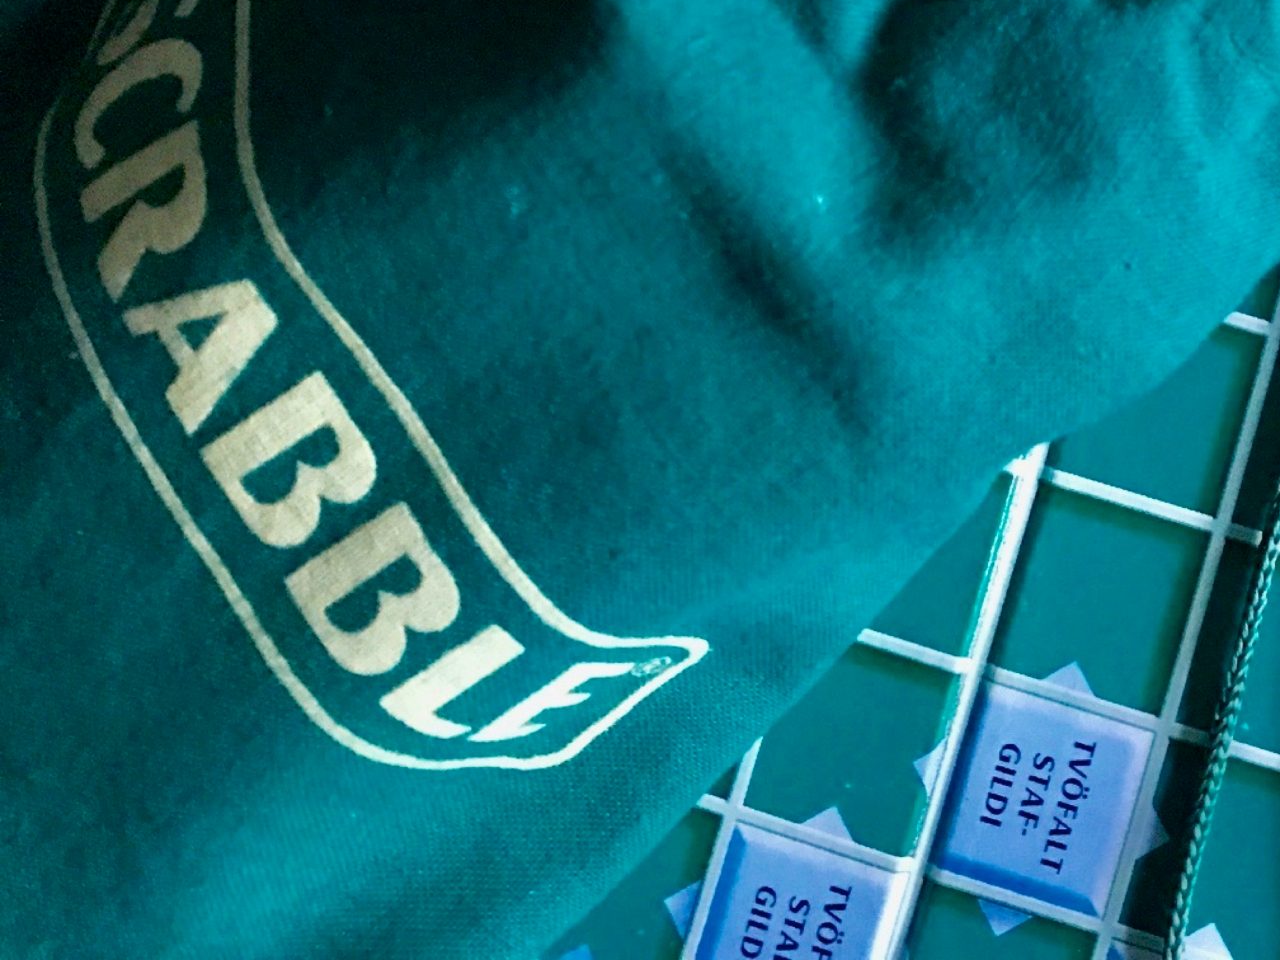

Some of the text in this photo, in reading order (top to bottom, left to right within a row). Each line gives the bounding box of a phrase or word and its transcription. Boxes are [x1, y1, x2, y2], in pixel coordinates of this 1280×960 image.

[980, 743, 1021, 827] GILDI
[1018, 753, 1055, 836] STAF-
[1040, 741, 1097, 875] TVÖFALT
[740, 885, 777, 959] GILD
